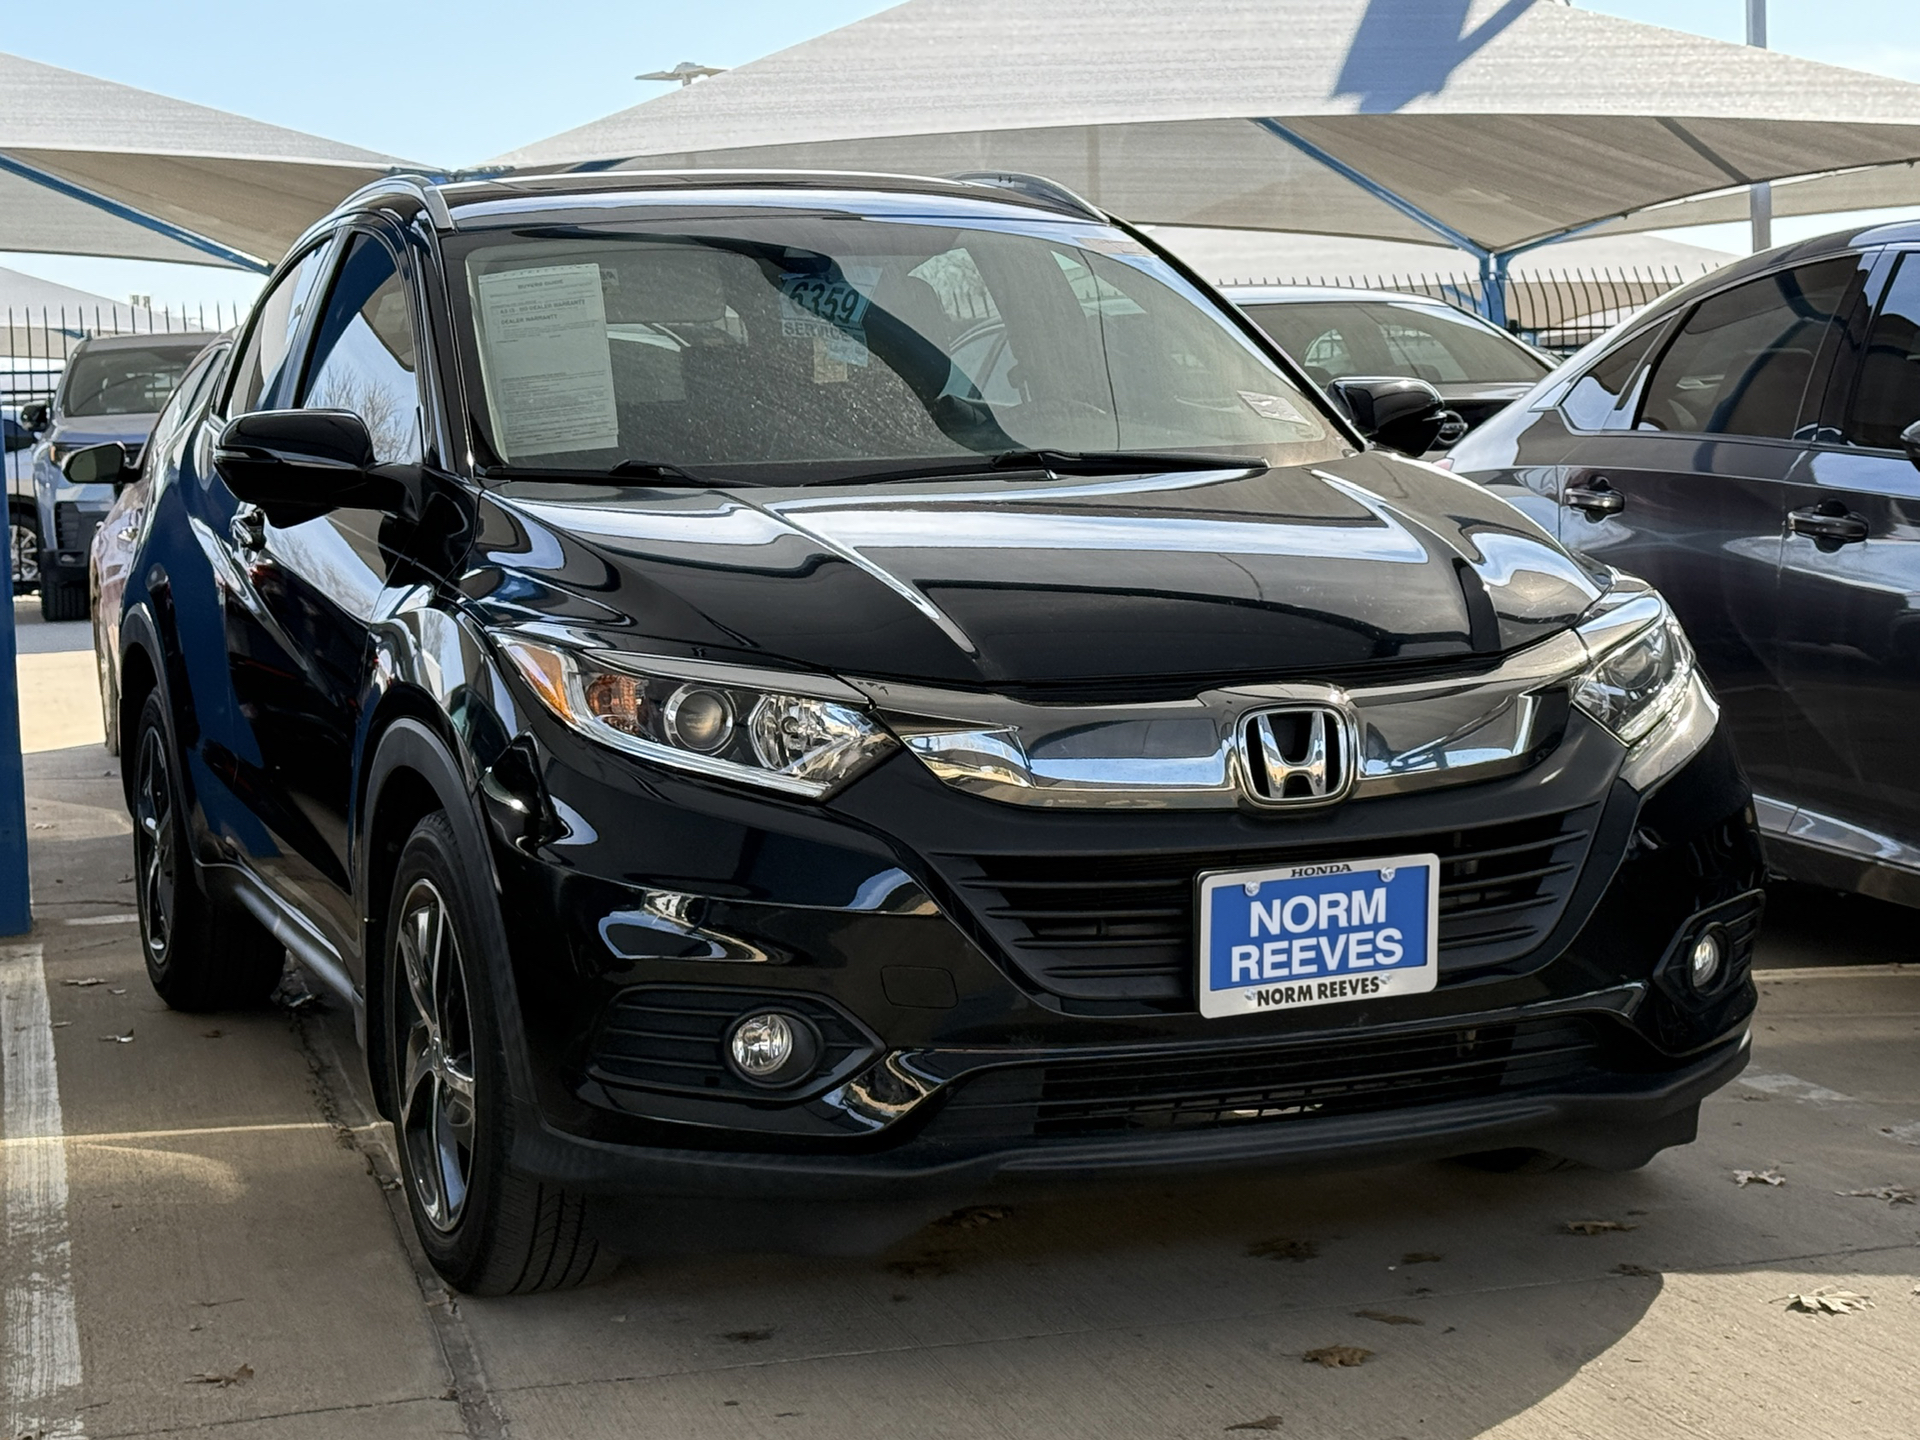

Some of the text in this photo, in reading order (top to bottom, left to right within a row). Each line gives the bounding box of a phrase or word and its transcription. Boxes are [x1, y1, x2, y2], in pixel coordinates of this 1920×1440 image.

[789, 281, 860, 324] 6359
[1290, 863, 1353, 878] HONDA
[1250, 886, 1387, 938] NORM
[1231, 927, 1404, 983] REEVES
[1257, 975, 1380, 1007] NORM REEVES
